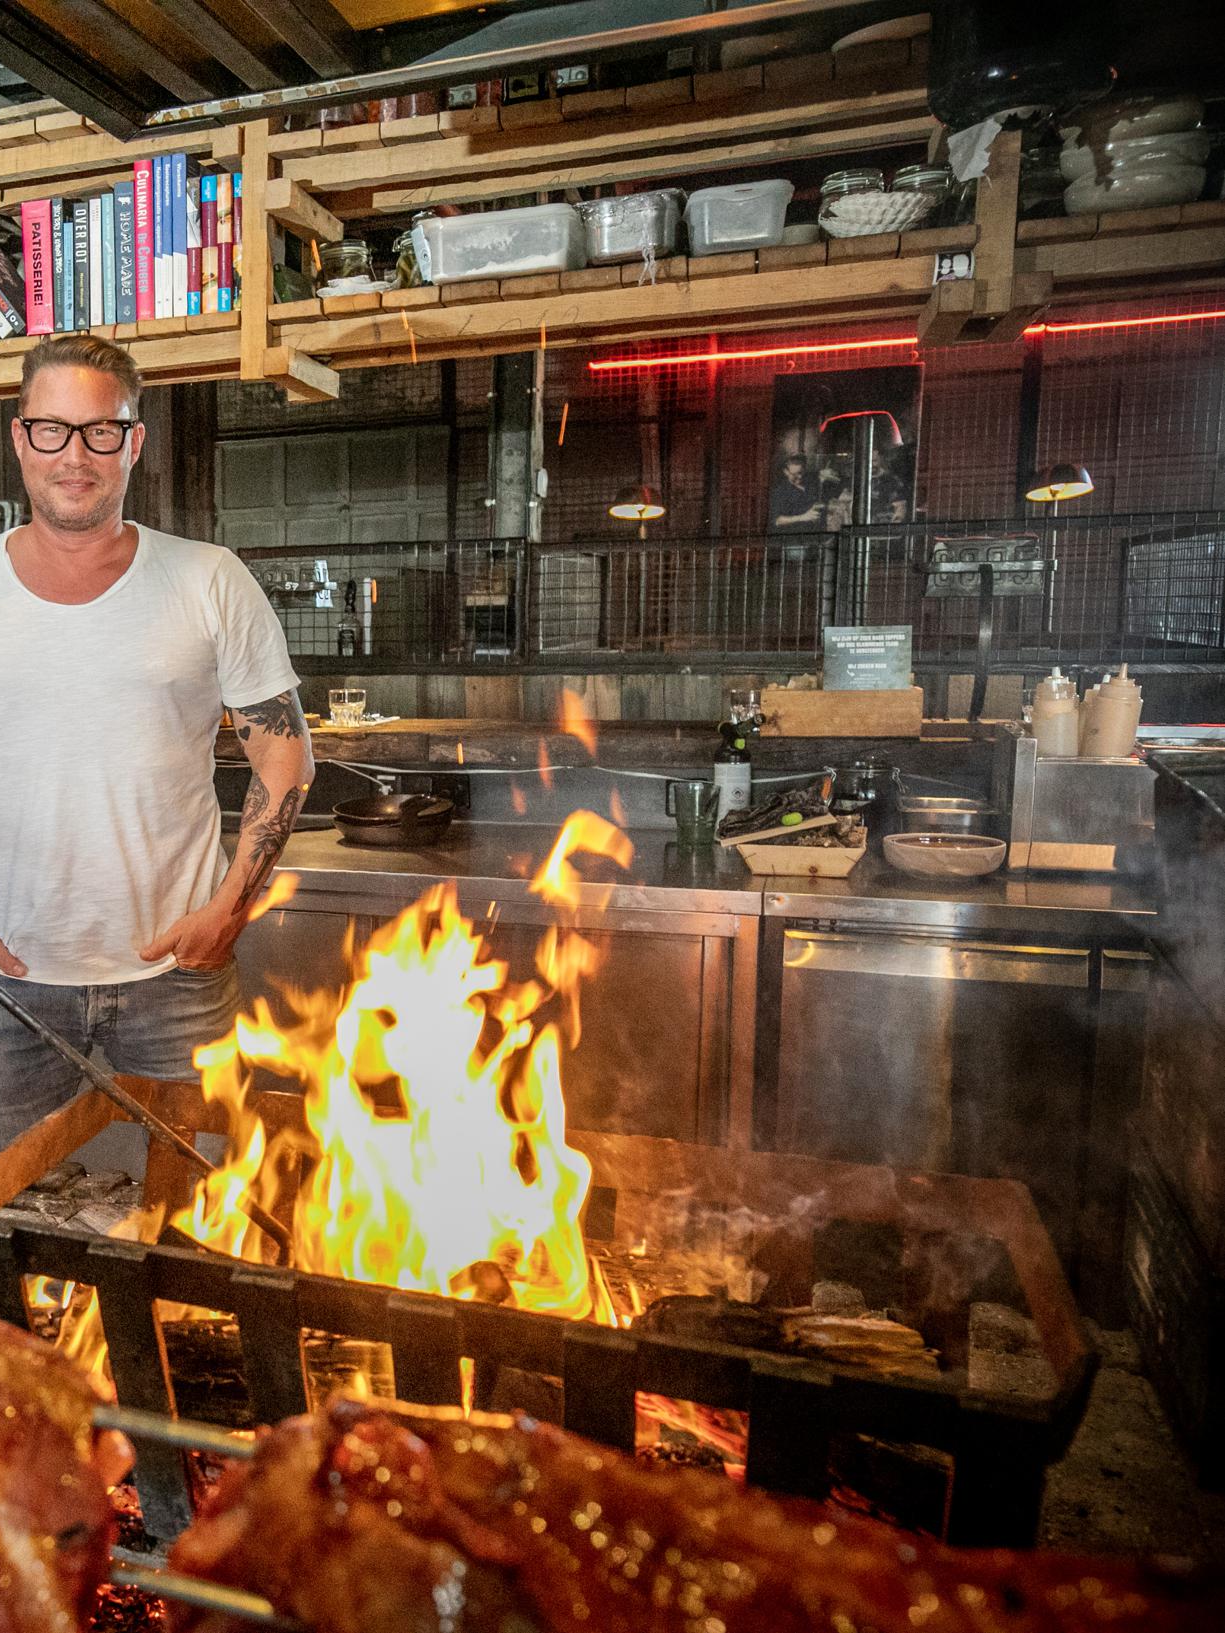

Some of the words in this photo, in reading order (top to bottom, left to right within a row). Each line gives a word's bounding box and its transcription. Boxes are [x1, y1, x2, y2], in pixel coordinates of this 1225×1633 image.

[136, 170, 150, 228] CULINARIA
[76, 209, 86, 238] OVER
[120, 212, 132, 252] HOME
[32, 222, 44, 306] PATISSERIE!
[76, 242, 88, 264] ROT
[121, 255, 132, 296] MADE
